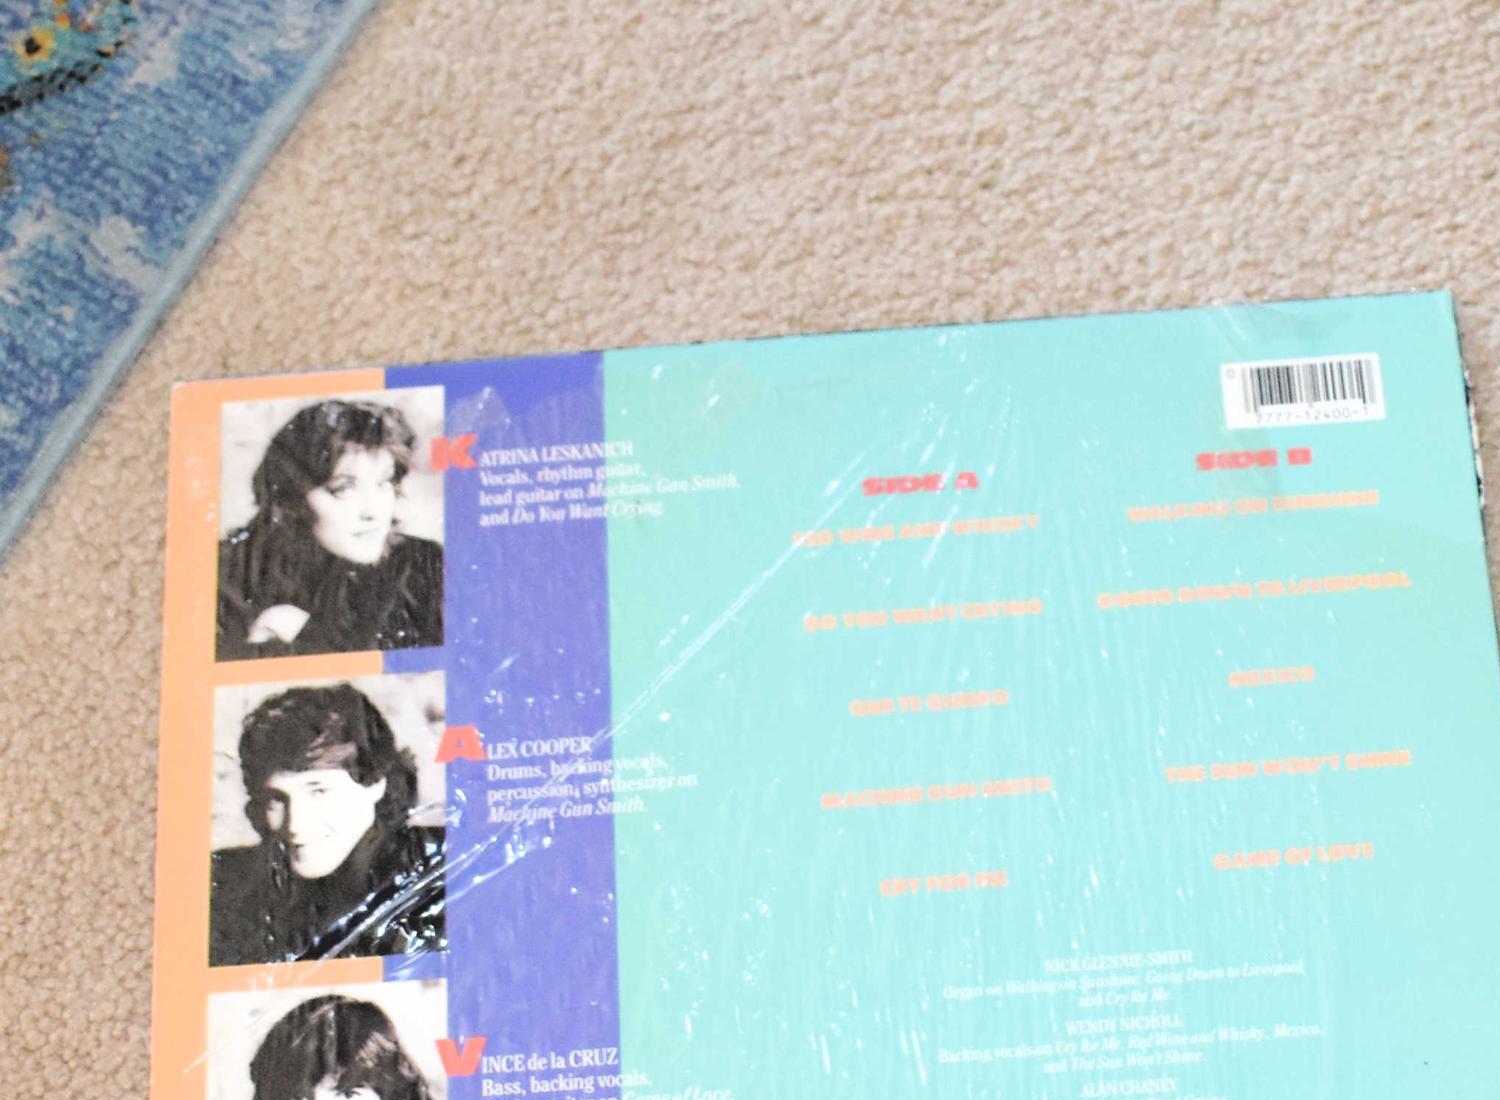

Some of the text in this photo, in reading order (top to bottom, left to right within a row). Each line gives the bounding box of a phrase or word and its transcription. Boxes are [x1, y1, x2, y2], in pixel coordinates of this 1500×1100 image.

[537, 464, 592, 485] rhythm
[480, 489, 512, 505] lead
[515, 485, 560, 507] guitar
[563, 488, 584, 499] on
[480, 509, 508, 525] and
[511, 507, 535, 523] Do
[539, 505, 565, 521] You
[520, 736, 592, 757] COOPER
[677, 775, 698, 788] on
[559, 801, 592, 817] Gun
[528, 1053, 547, 1070] de
[550, 1051, 566, 1068] la
[569, 1048, 618, 1067] CRUZ
[483, 1077, 527, 1097] Bass,
[530, 1073, 594, 1096] backing
